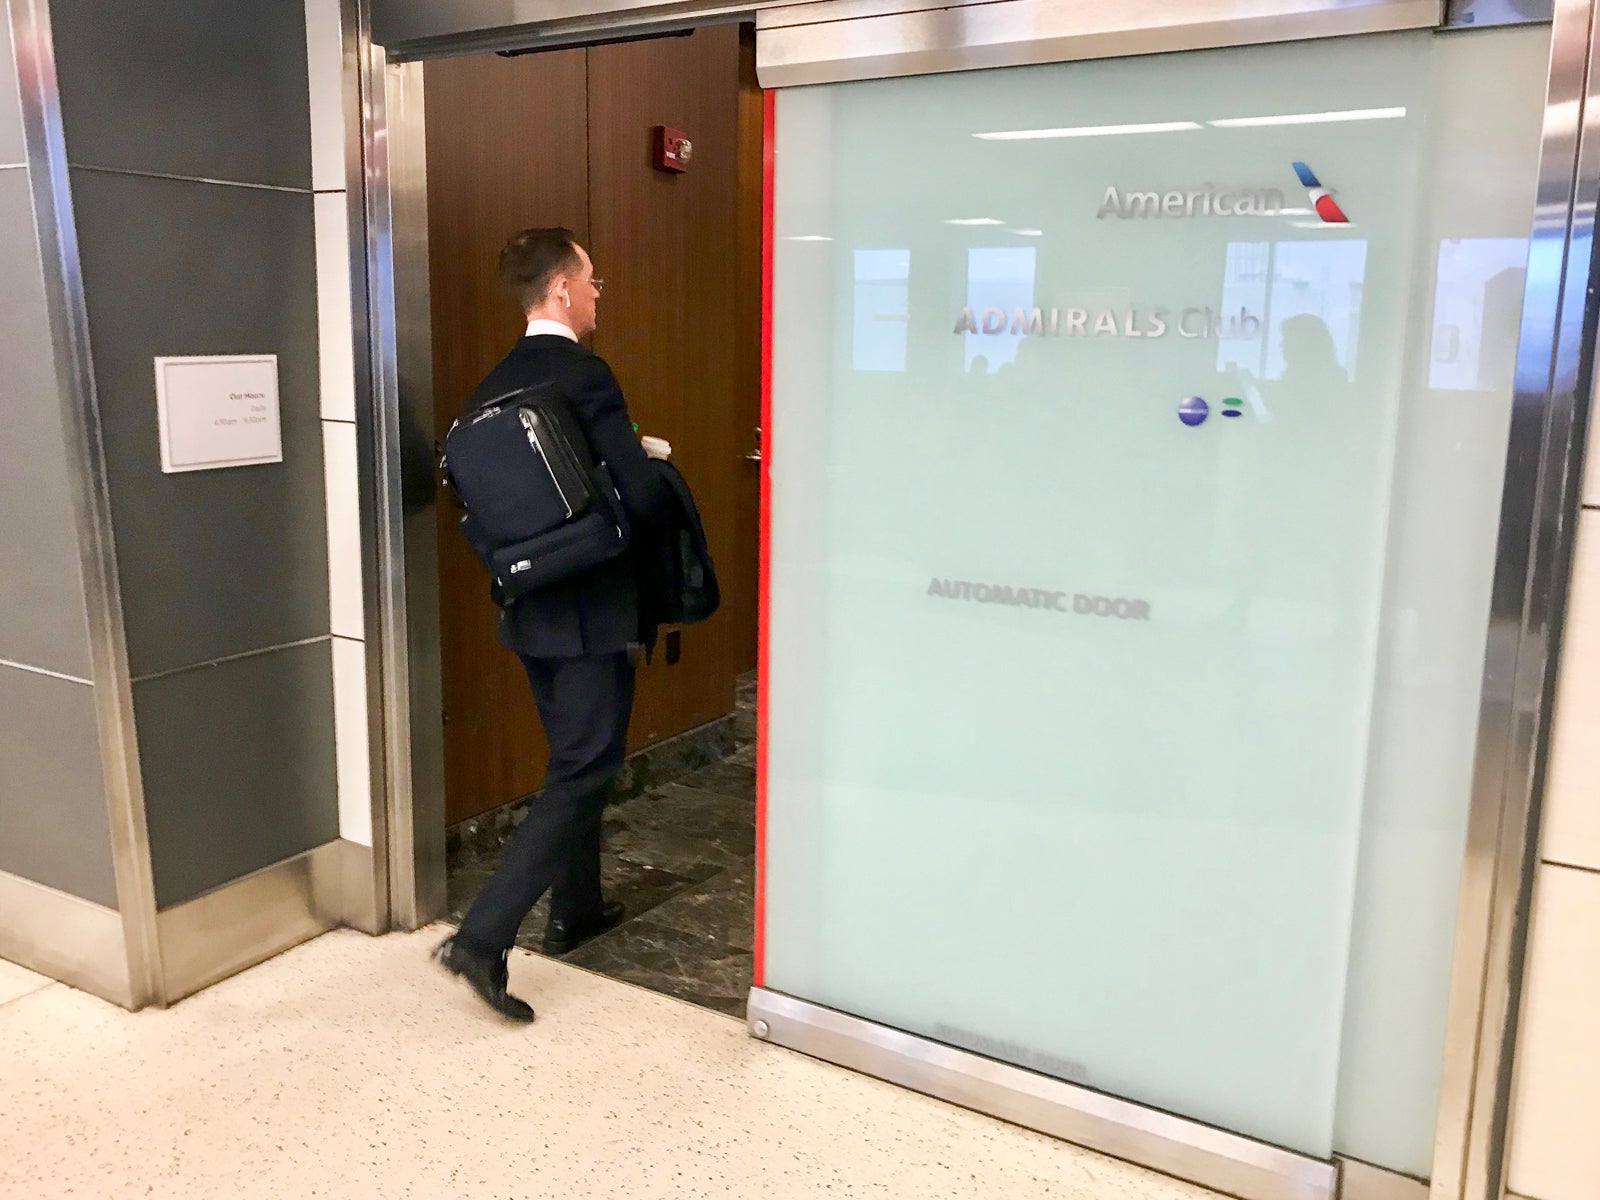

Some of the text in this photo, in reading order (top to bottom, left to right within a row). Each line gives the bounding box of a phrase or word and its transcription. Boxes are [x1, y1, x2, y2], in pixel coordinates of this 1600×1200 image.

[1096, 184, 1284, 219] American
[953, 305, 1261, 338] ADMIRALS Club
[927, 577, 1151, 622] AUTOMATIC DOOR
